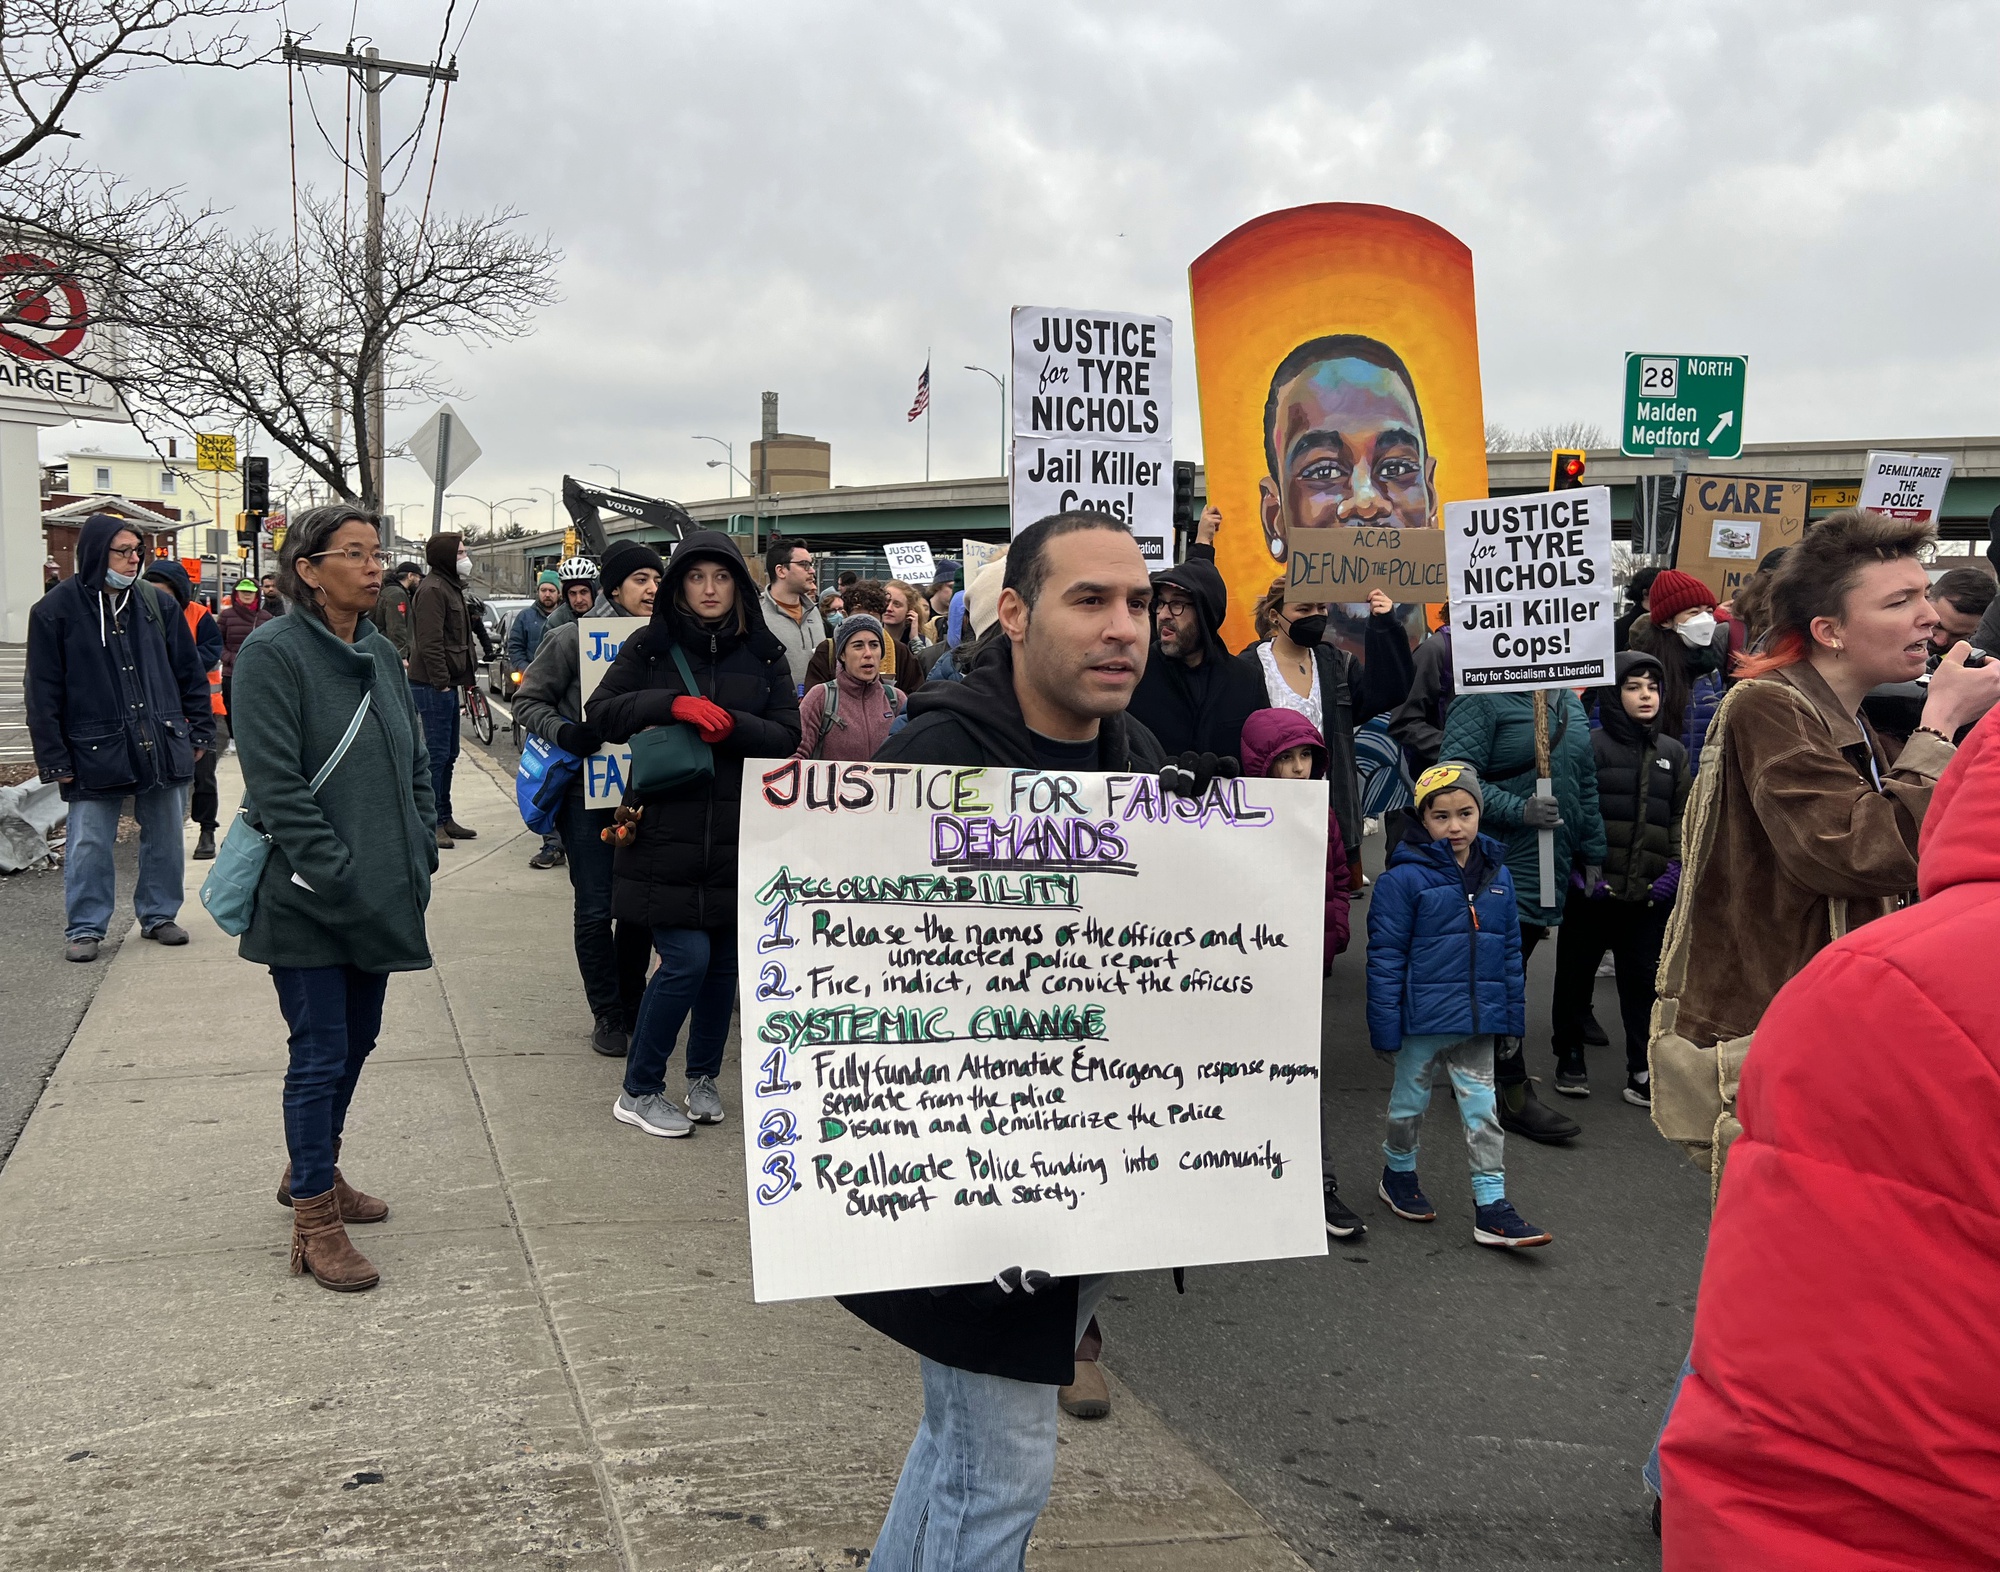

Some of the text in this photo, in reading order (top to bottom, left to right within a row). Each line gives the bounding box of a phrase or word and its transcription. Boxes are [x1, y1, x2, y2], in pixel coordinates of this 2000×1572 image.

[1033, 317, 1156, 358] JUSTICE
[0, 364, 91, 394] ARGET
[1039, 355, 1150, 396] for TYRE
[1644, 358, 1733, 388] 28 NORTH
[1032, 396, 1159, 434] NICHOLS
[1637, 402, 1697, 422] Malden
[1632, 425, 1700, 446] Medford
[1028, 448, 1162, 486] Jail Killer
[1878, 464, 1942, 478] DEMILITARIZE
[1699, 480, 1784, 514] CARE
[1813, 495, 1826, 503] FT
[1836, 491, 1845, 503] 3
[1881, 493, 1925, 507] POLICE
[1899, 480, 1917, 492] THE
[606, 500, 643, 515] VOLVO
[1463, 499, 1590, 537] JUSTICE
[888, 545, 927, 555] JUSTICE
[1353, 530, 1401, 549] ACAB
[1470, 529, 1584, 568] for TYRE
[896, 571, 935, 581] FAISAL!
[897, 554, 925, 565] FOR
[1291, 551, 1446, 588] DEFUND THE POLICE
[1463, 558, 1595, 595] NICHOLS
[1462, 597, 1600, 630] Jail Killer
[1492, 628, 1571, 663] Cops!
[1465, 664, 1601, 684] Party for Socialism & Liberation
[762, 759, 1274, 829] JUSTICE FOR FAISAL
[931, 813, 1129, 863] DEMANDS
[755, 866, 1079, 905] ACCOUNTABILITY
[758, 898, 1289, 954] 1. Release the names of the officers and the
[889, 943, 1179, 978] unredacted police report
[756, 960, 1254, 1001] 2. Fire, indict, and convict the officers
[757, 1004, 1106, 1053] SYSTEMIC CHANGE
[756, 1047, 802, 1097] 1.
[811, 1050, 870, 1097] Fully
[871, 1054, 922, 1086] fund
[922, 1064, 950, 1085] an
[956, 1051, 1064, 1081] Alternative
[1197, 1059, 1264, 1084] response
[916, 1090, 963, 1111] from
[967, 1084, 1008, 1111] the
[1010, 1083, 1067, 1114] police
[757, 1108, 802, 1149] 2.
[817, 1116, 920, 1144] Disarm
[929, 1113, 972, 1134] and
[980, 1108, 1123, 1136] demilitarize
[1127, 1103, 1165, 1130] the
[756, 1139, 1291, 1206] 3. Reallocate Police funding into community
[954, 1183, 1002, 1207] and
